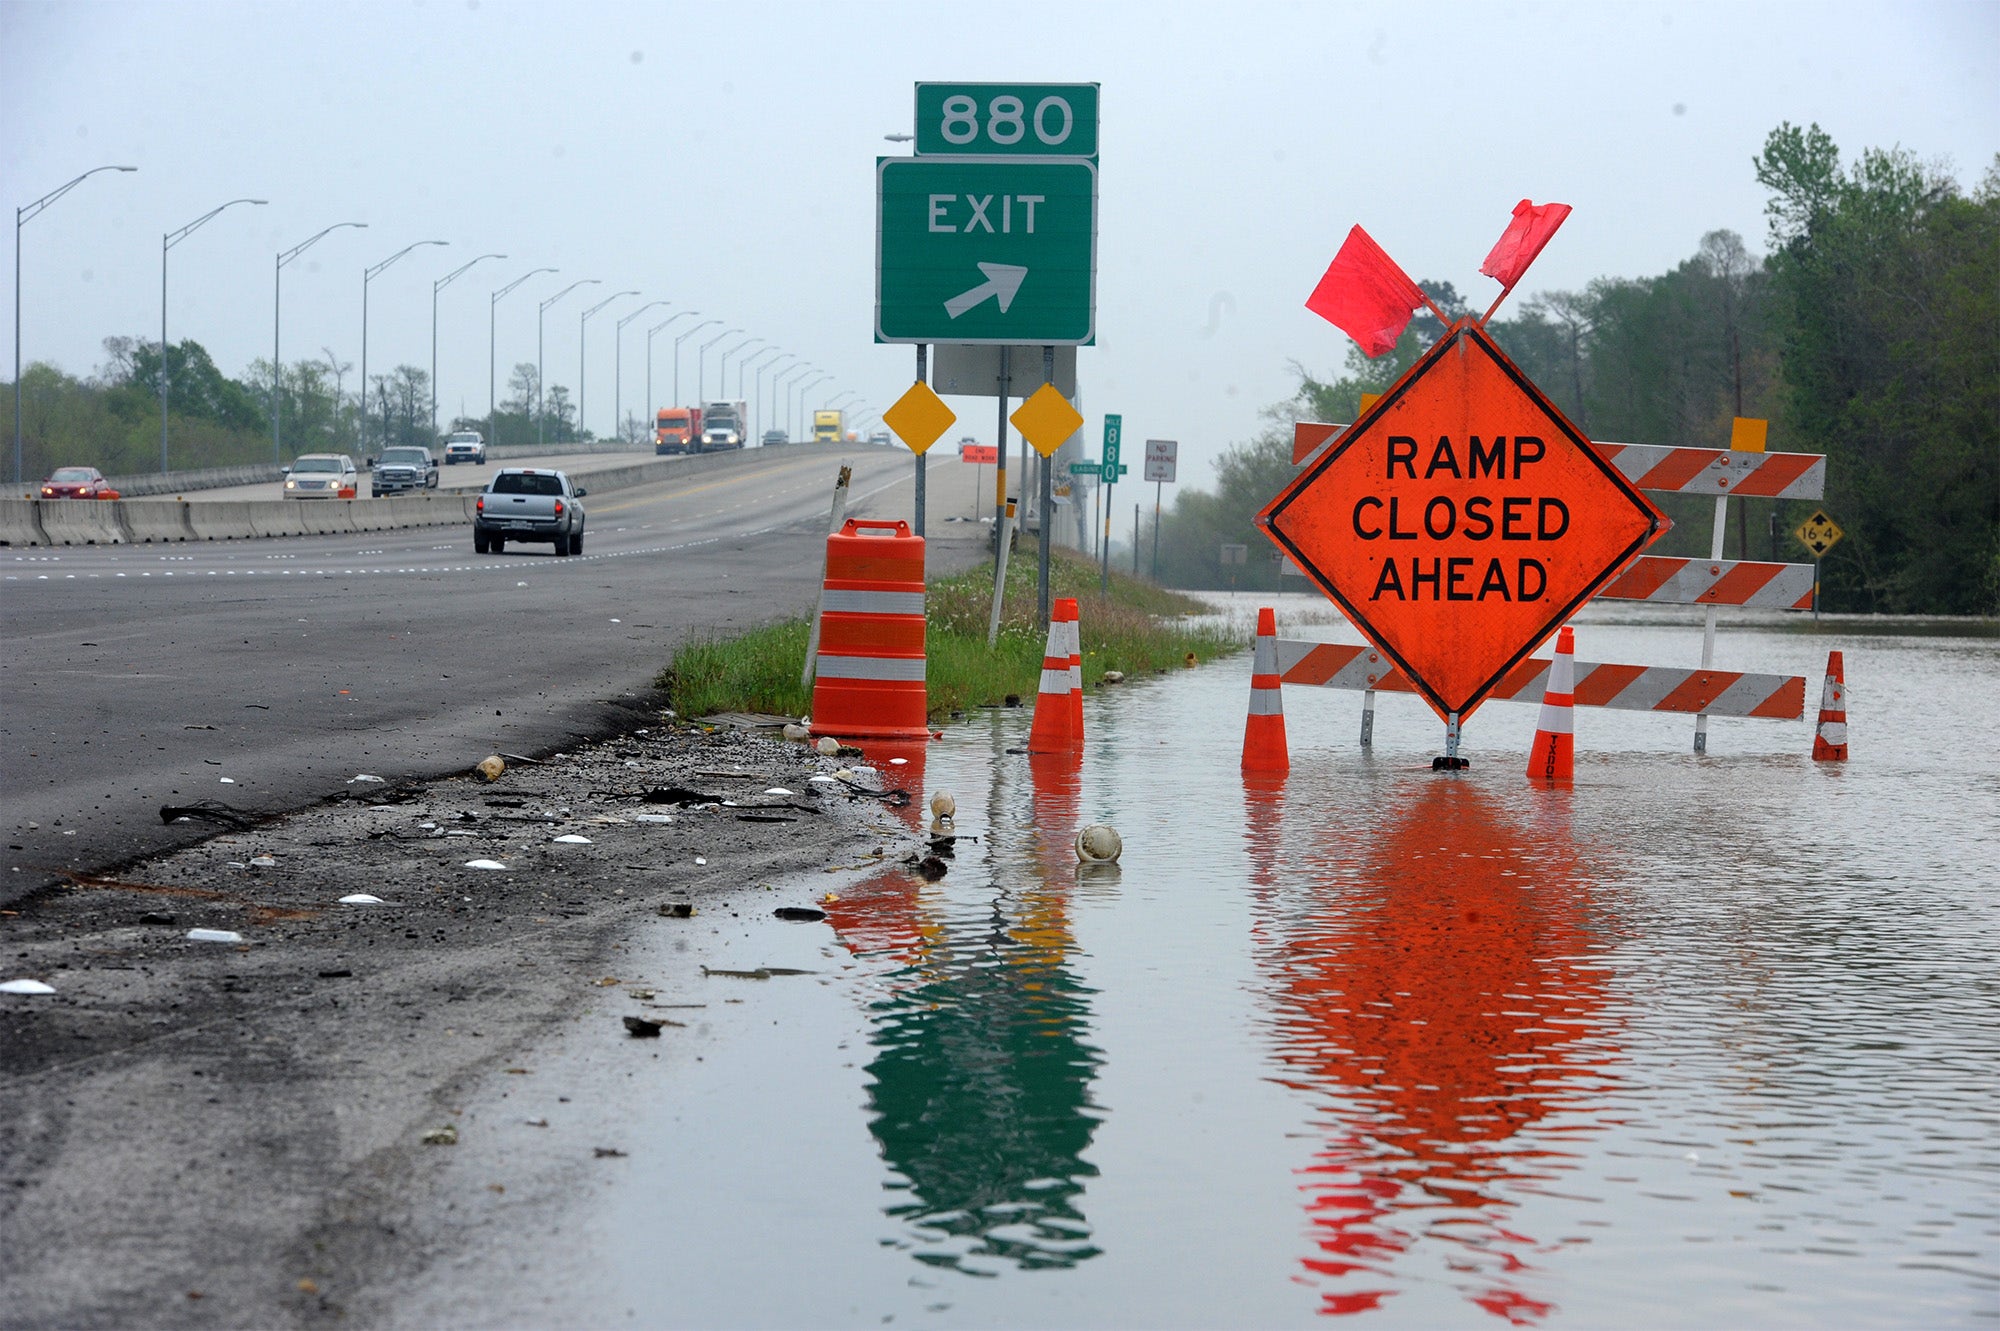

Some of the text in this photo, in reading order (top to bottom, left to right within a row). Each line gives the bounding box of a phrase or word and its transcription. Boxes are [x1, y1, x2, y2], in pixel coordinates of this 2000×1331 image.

[940, 94, 1074, 145] 880
[928, 193, 1046, 234] EXIT
[1156, 444, 1168, 453] NO
[1386, 435, 1546, 480] RAMP
[1352, 495, 1570, 541] CLOSED
[1372, 557, 1548, 602] AHEAD
